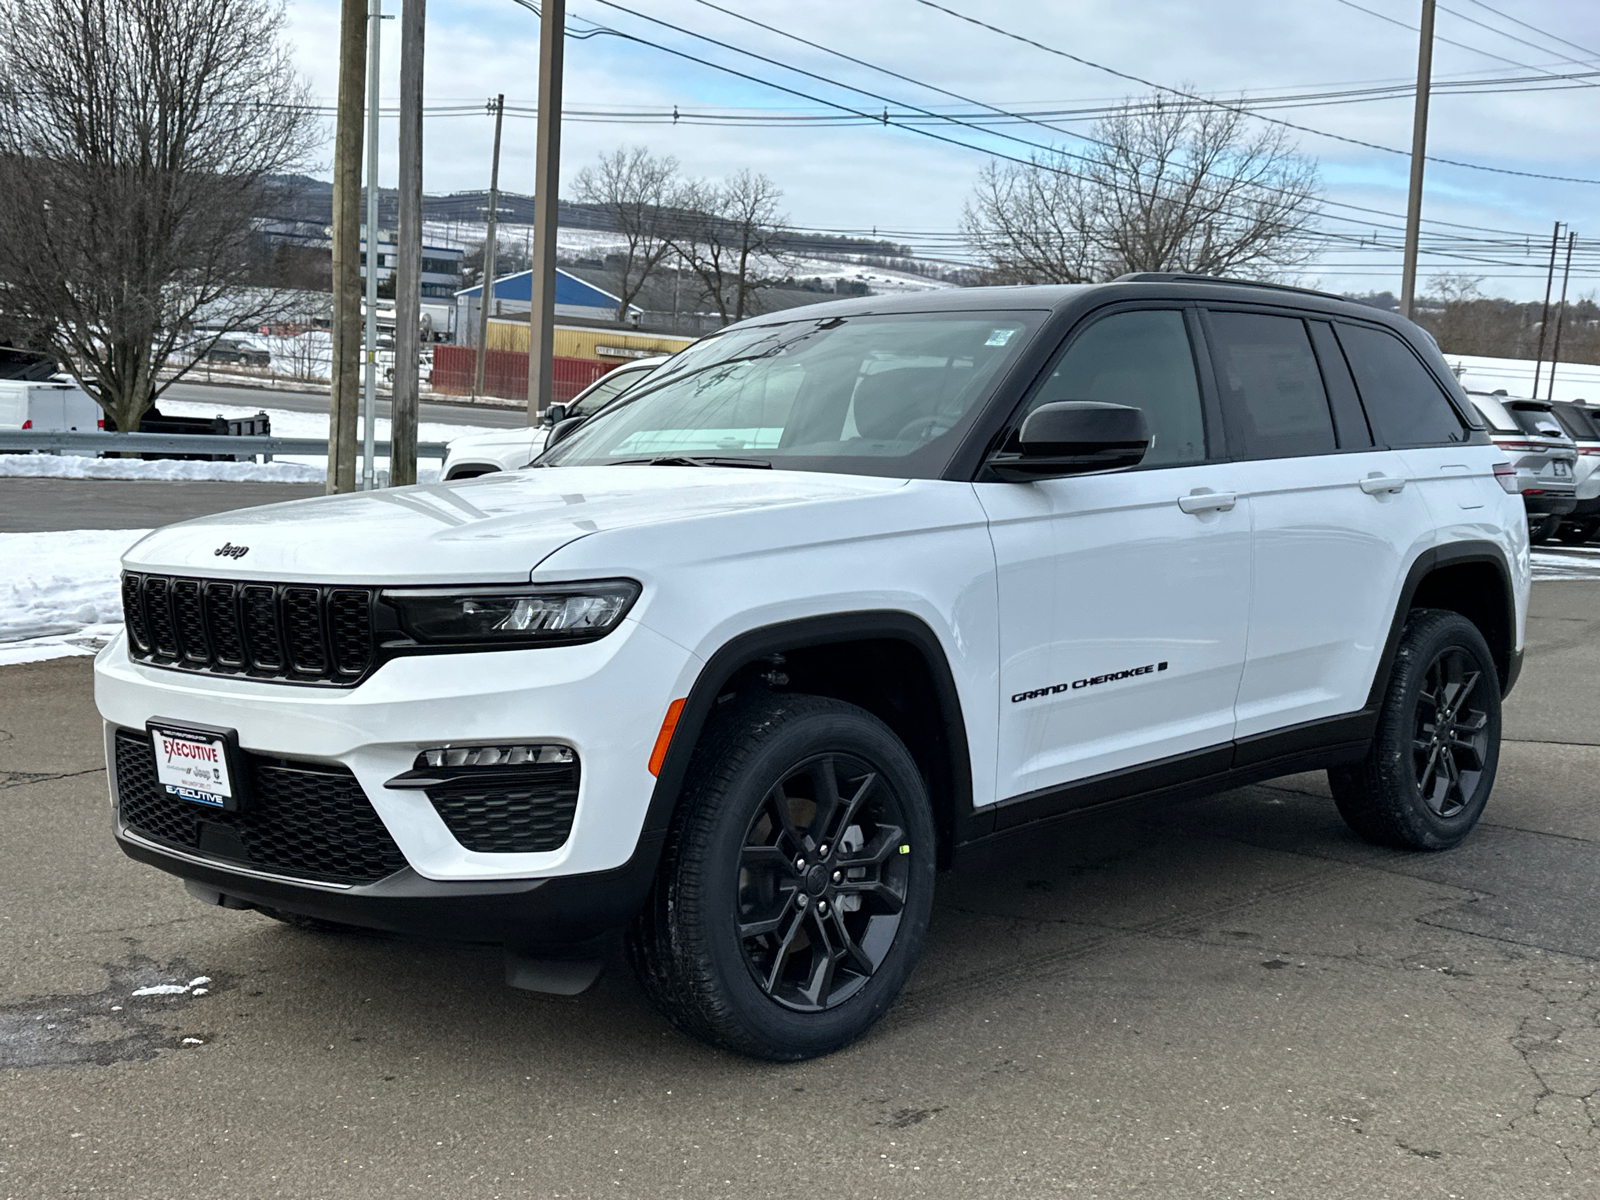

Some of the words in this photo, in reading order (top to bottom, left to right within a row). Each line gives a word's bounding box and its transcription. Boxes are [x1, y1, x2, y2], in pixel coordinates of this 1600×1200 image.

[214, 542, 250, 560] Jeep
[1011, 683, 1068, 703] GRAND
[1072, 664, 1155, 689] CHEROKEE
[163, 738, 218, 763] EXECUTIVE
[165, 785, 223, 804] EXECUTIVE
